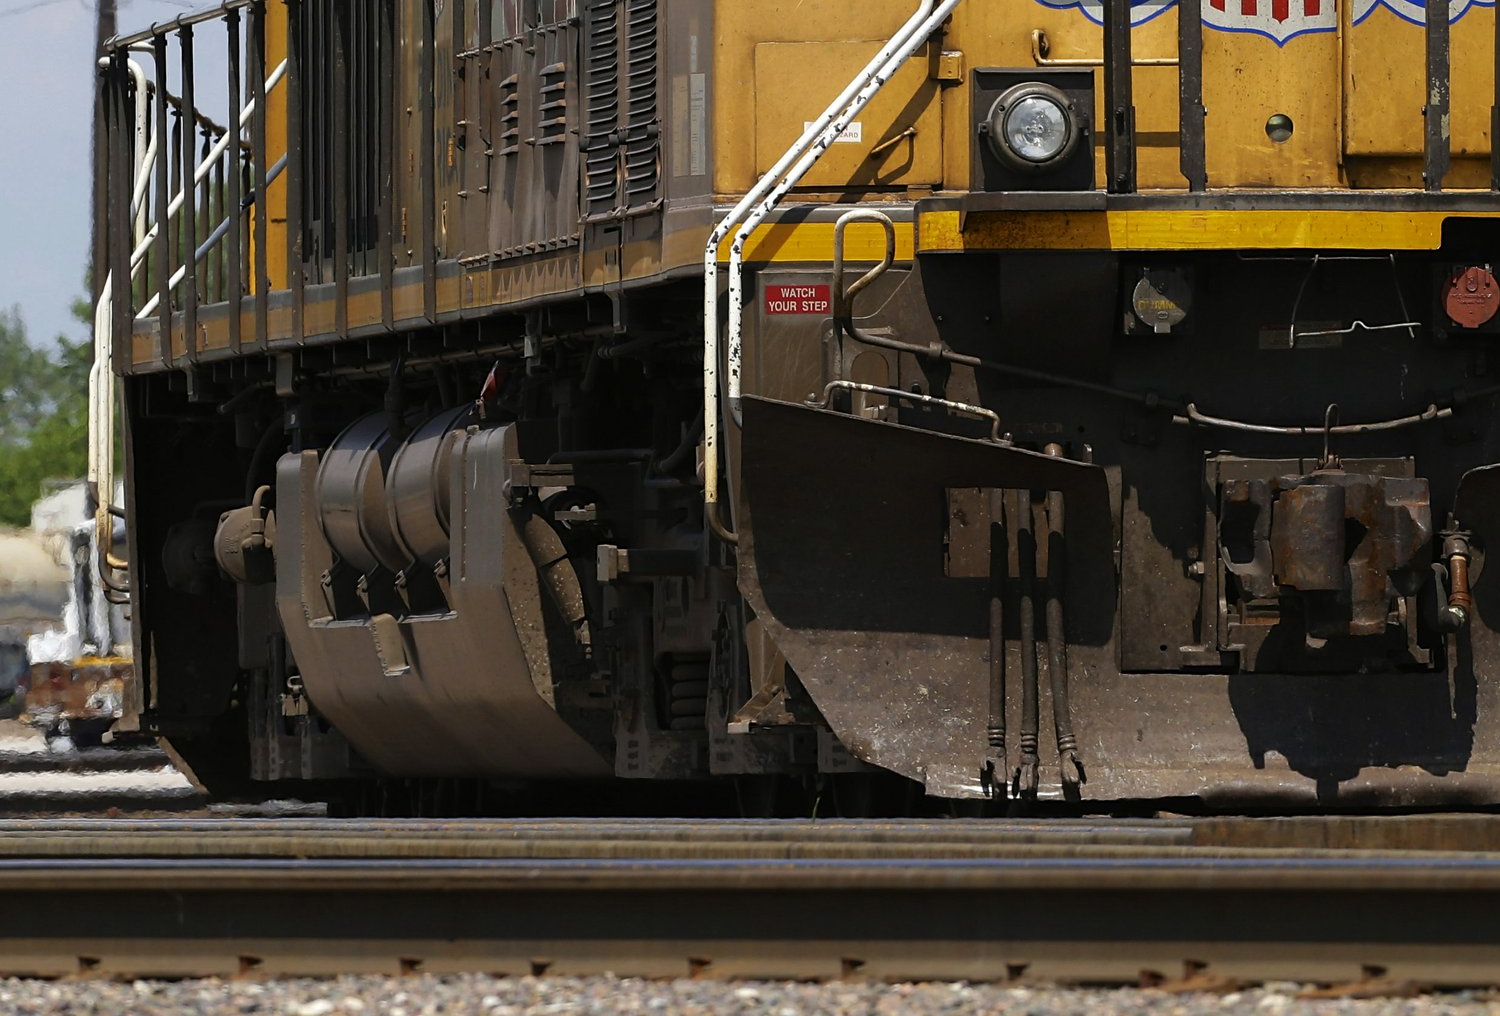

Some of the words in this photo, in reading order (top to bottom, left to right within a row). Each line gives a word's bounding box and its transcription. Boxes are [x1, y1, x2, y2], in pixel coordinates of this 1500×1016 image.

[781, 287, 816, 298] WATCH
[768, 301, 797, 312] YOUR
[802, 301, 828, 312] STEP
